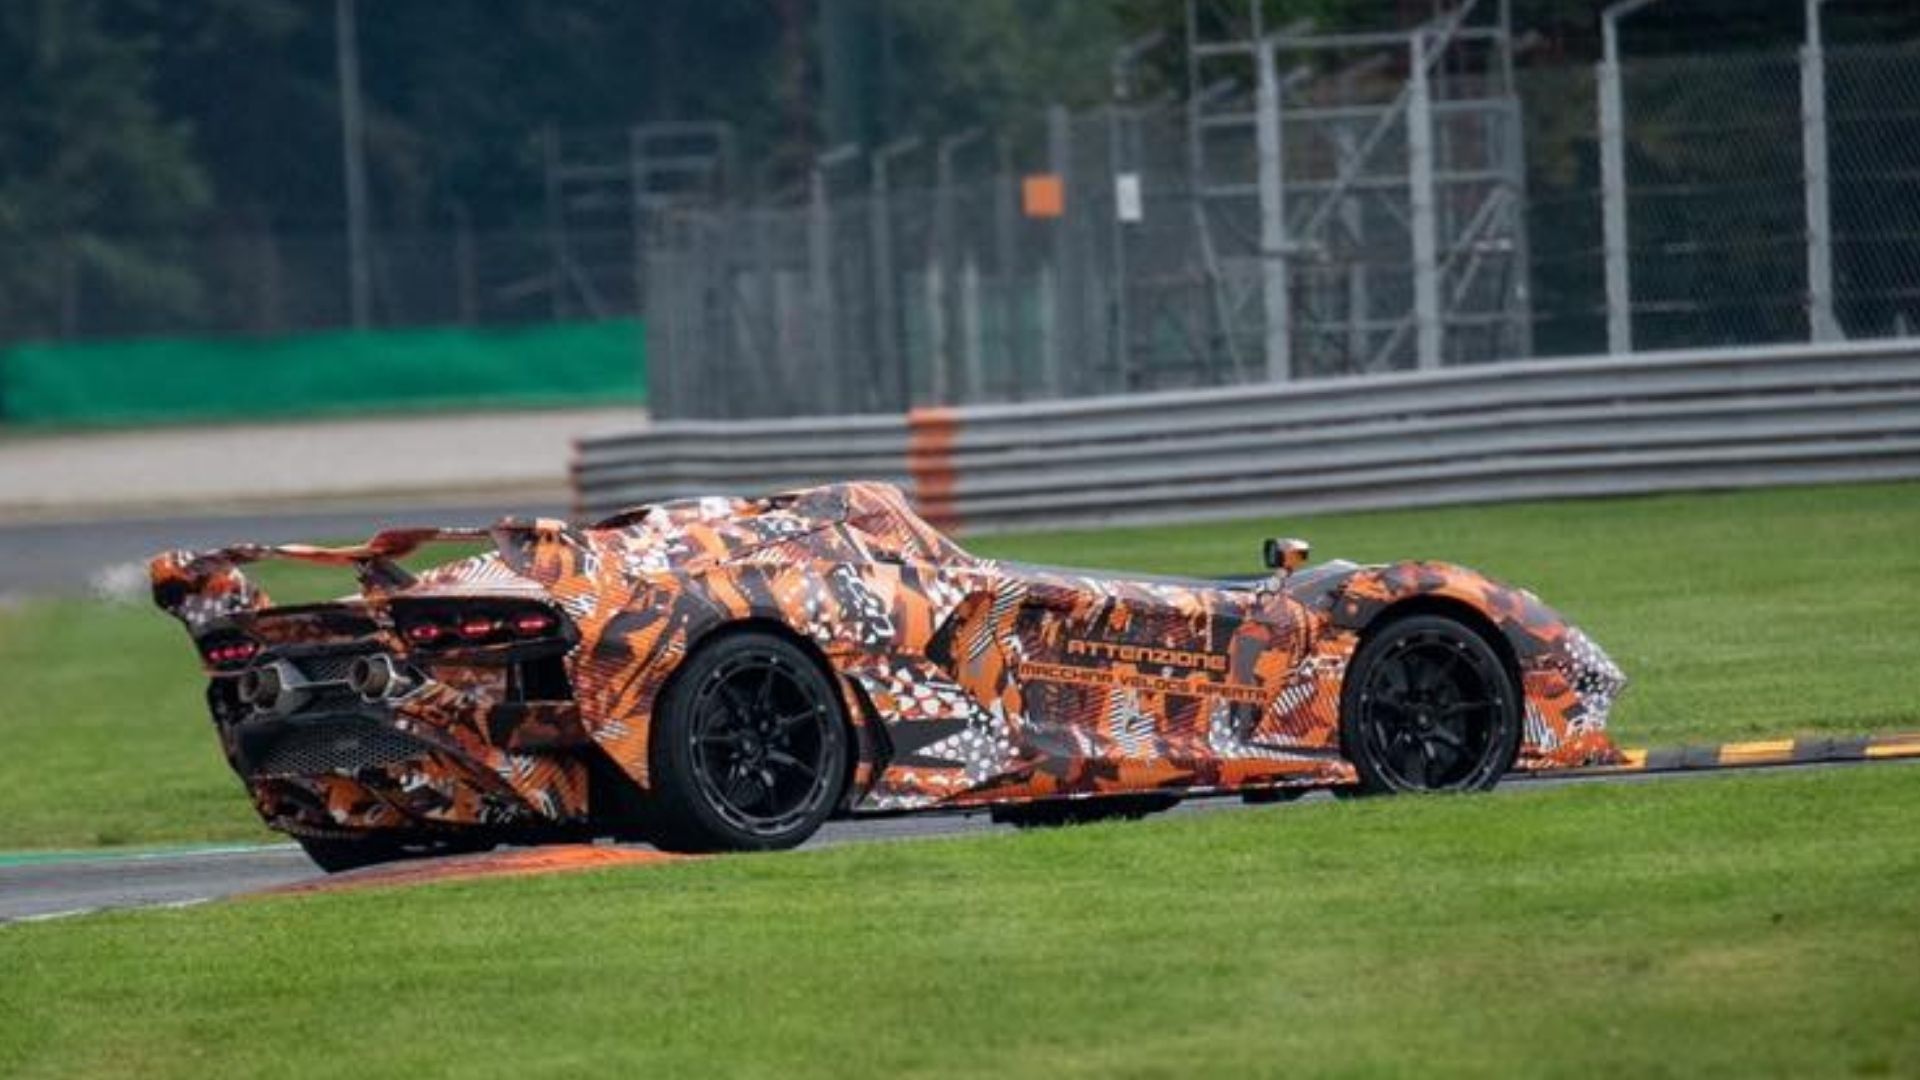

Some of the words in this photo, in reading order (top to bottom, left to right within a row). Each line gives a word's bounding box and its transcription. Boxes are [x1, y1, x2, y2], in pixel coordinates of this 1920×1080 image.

[1068, 639, 1226, 670] ATTENZIONE
[1021, 663, 1113, 682] MACCHINA
[1196, 683, 1268, 700] APERTA
